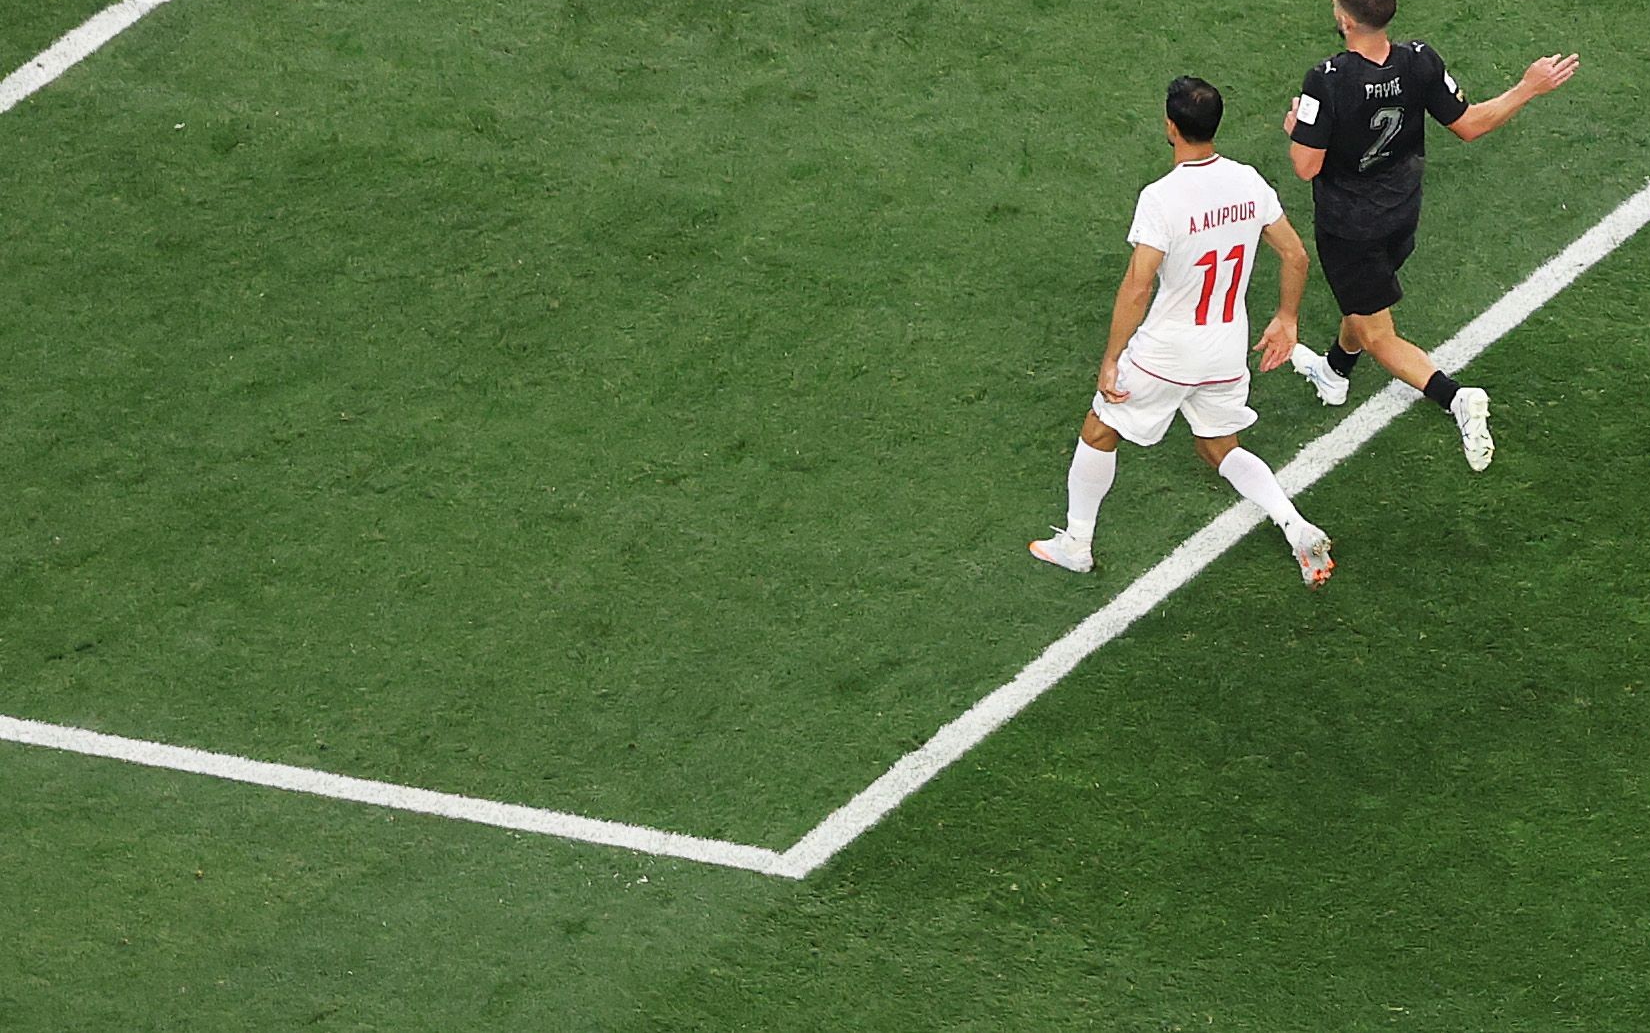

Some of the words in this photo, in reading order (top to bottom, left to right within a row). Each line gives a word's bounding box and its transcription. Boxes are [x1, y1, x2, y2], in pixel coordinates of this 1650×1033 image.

[1364, 77, 1403, 100] PAYNE
[1359, 107, 1405, 172] 2
[1193, 244, 1245, 325] 11
